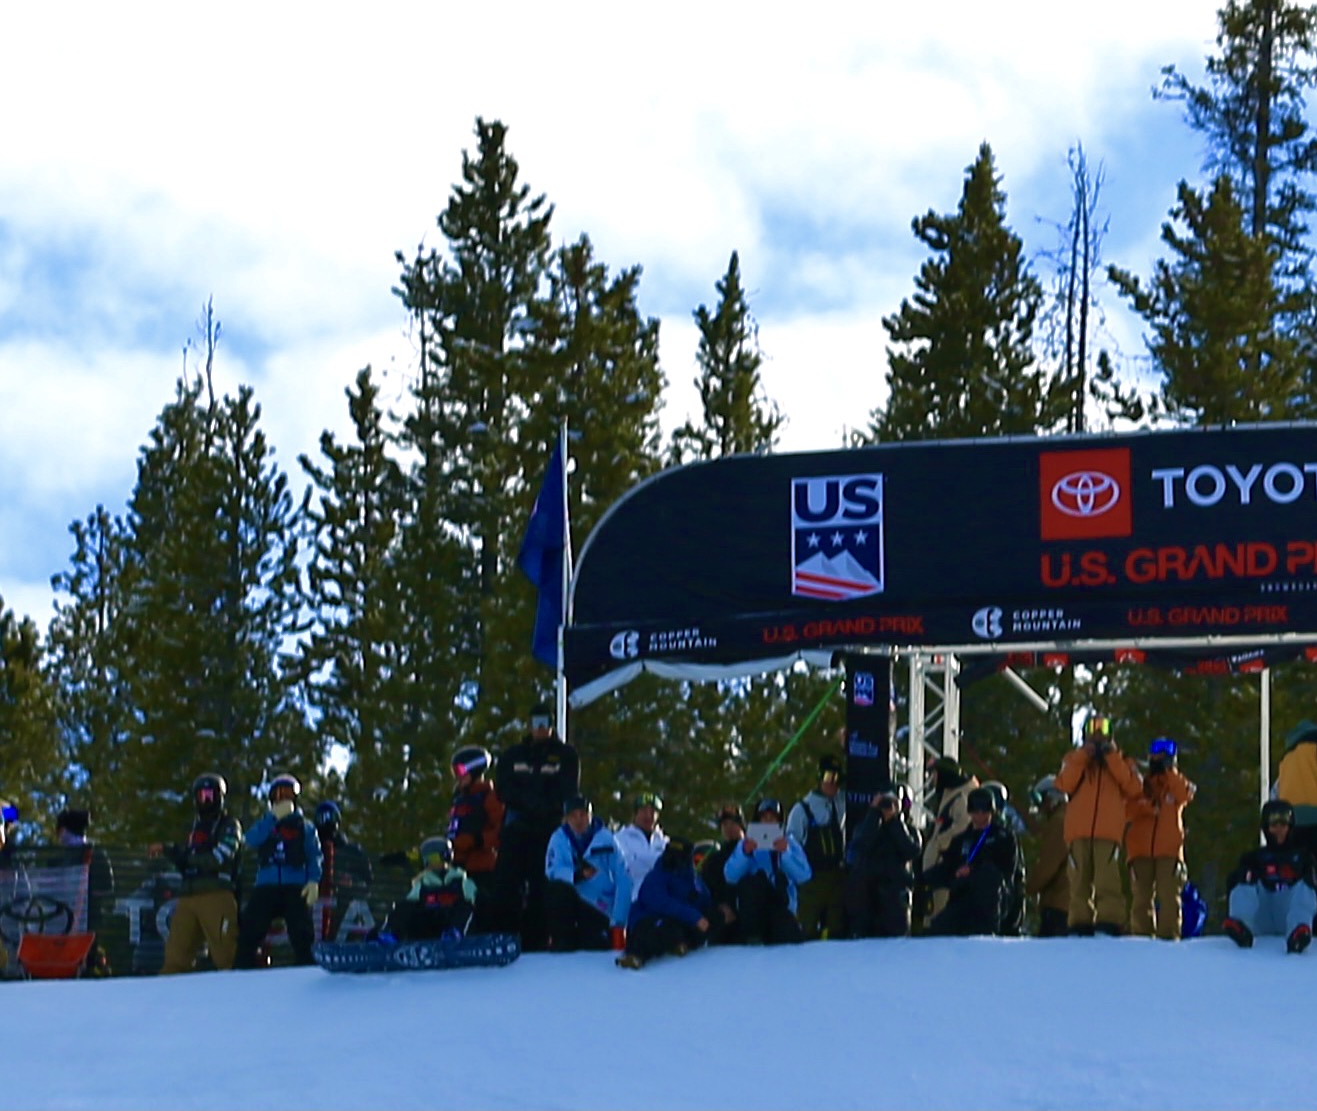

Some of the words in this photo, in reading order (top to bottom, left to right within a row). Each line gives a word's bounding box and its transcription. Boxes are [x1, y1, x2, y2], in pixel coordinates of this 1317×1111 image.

[794, 479, 880, 523] US
[1040, 551, 1117, 587] U.S.
[1125, 542, 1278, 584] GRAND
[1012, 608, 1064, 621] COPPER
[1012, 618, 1082, 632] MOUNTAIN
